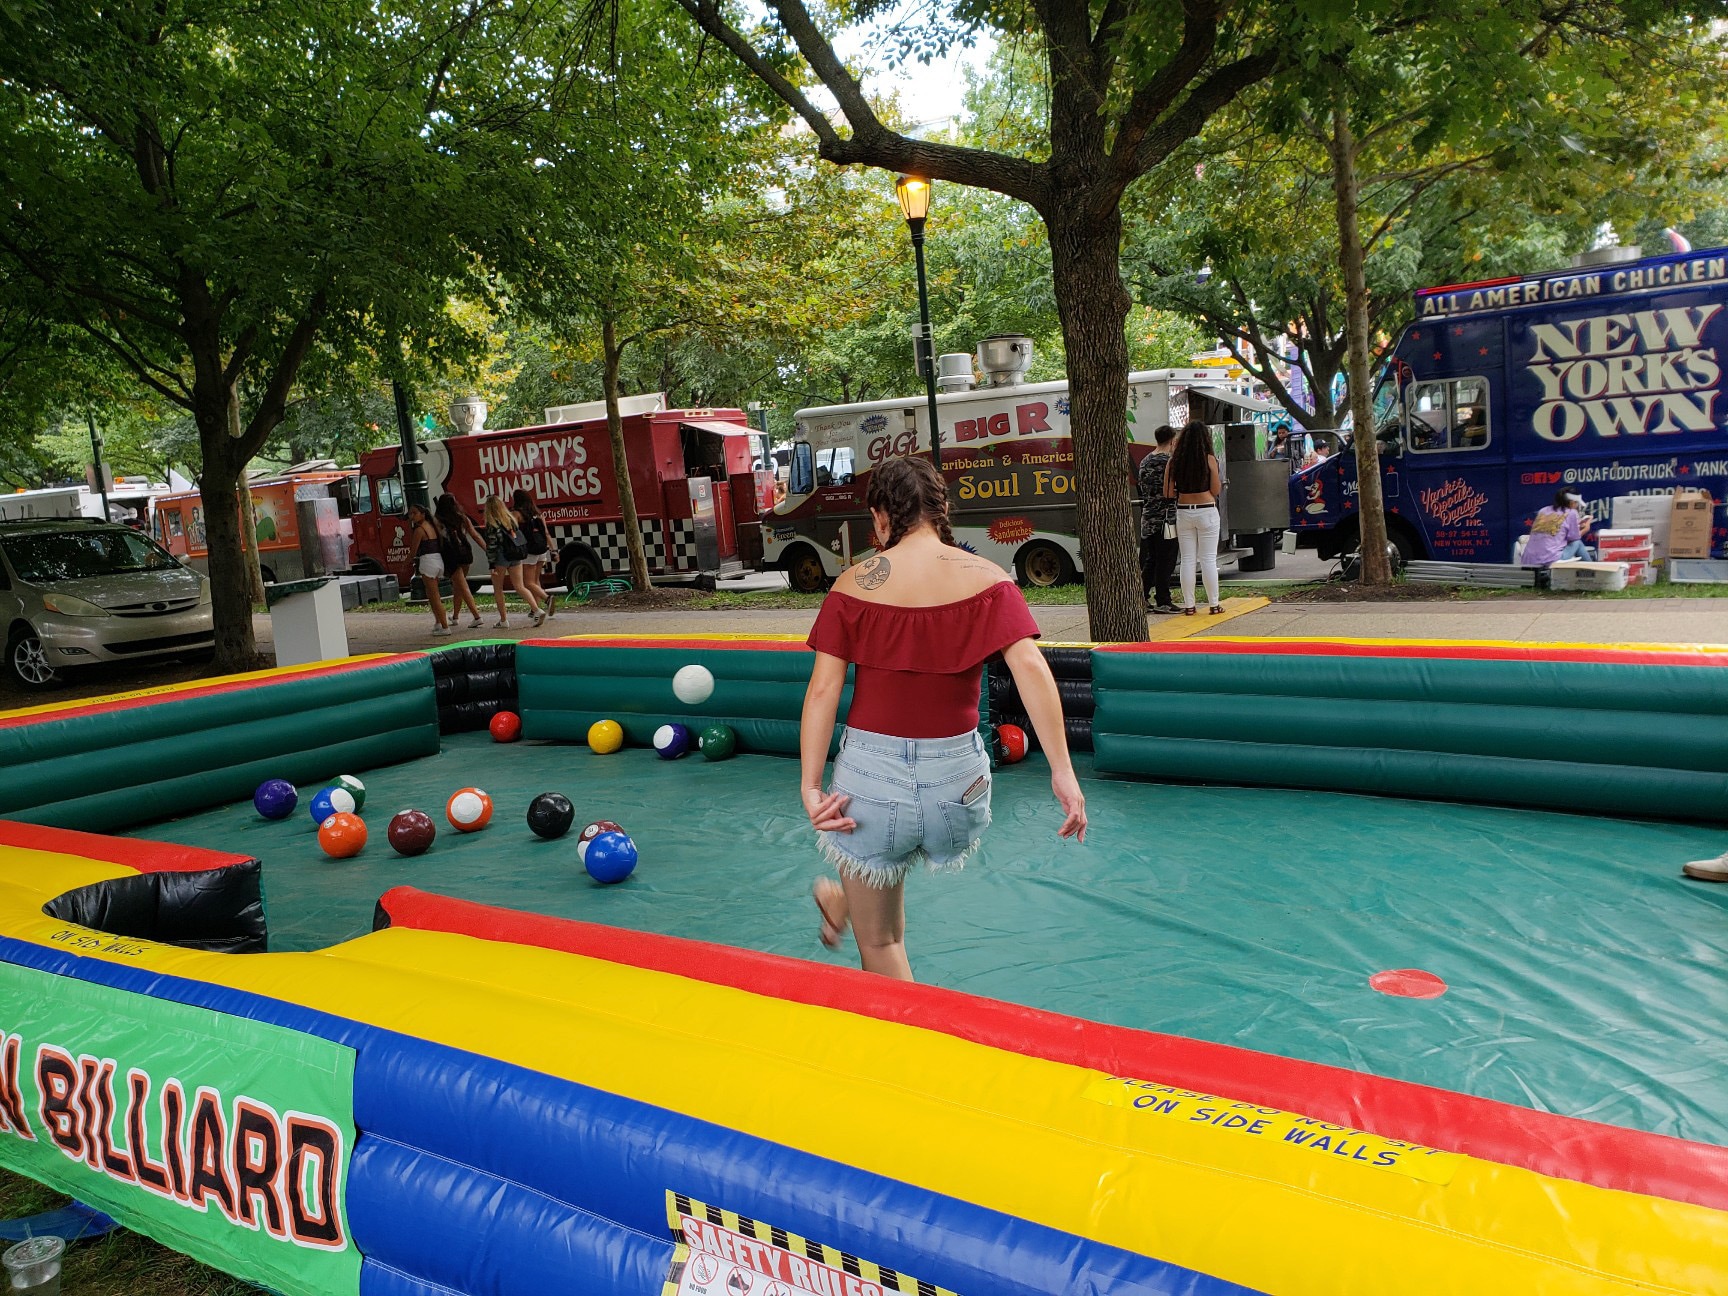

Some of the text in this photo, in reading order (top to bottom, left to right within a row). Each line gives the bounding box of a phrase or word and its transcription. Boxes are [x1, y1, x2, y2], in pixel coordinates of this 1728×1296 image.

[1423, 258, 1726, 315] ALL AMERICAN CHICKEN
[1529, 303, 1725, 364] NEW
[1526, 347, 1723, 401] YORK'S
[954, 412, 1011, 443] BIG
[1015, 401, 1053, 436] R
[1532, 389, 1723, 443] OWN
[478, 435, 587, 475] HUMPTY'S
[941, 452, 1074, 471] aribbean & America
[1563, 463, 1675, 484] @USAFOODTRUCK
[473, 467, 602, 505] DUMPLINGS
[958, 470, 1077, 500] Soul Fo
[1420, 477, 1466, 513] Yankee
[541, 506, 590, 522] ptysMobile
[993, 527, 1033, 541] Sandwiches
[999, 519, 1024, 529] Delicious
[35, 1043, 348, 1252] BILLIARD
[1132, 1095, 1402, 1166] ON SIDE WALLS
[681, 1217, 784, 1280] SAFETY
